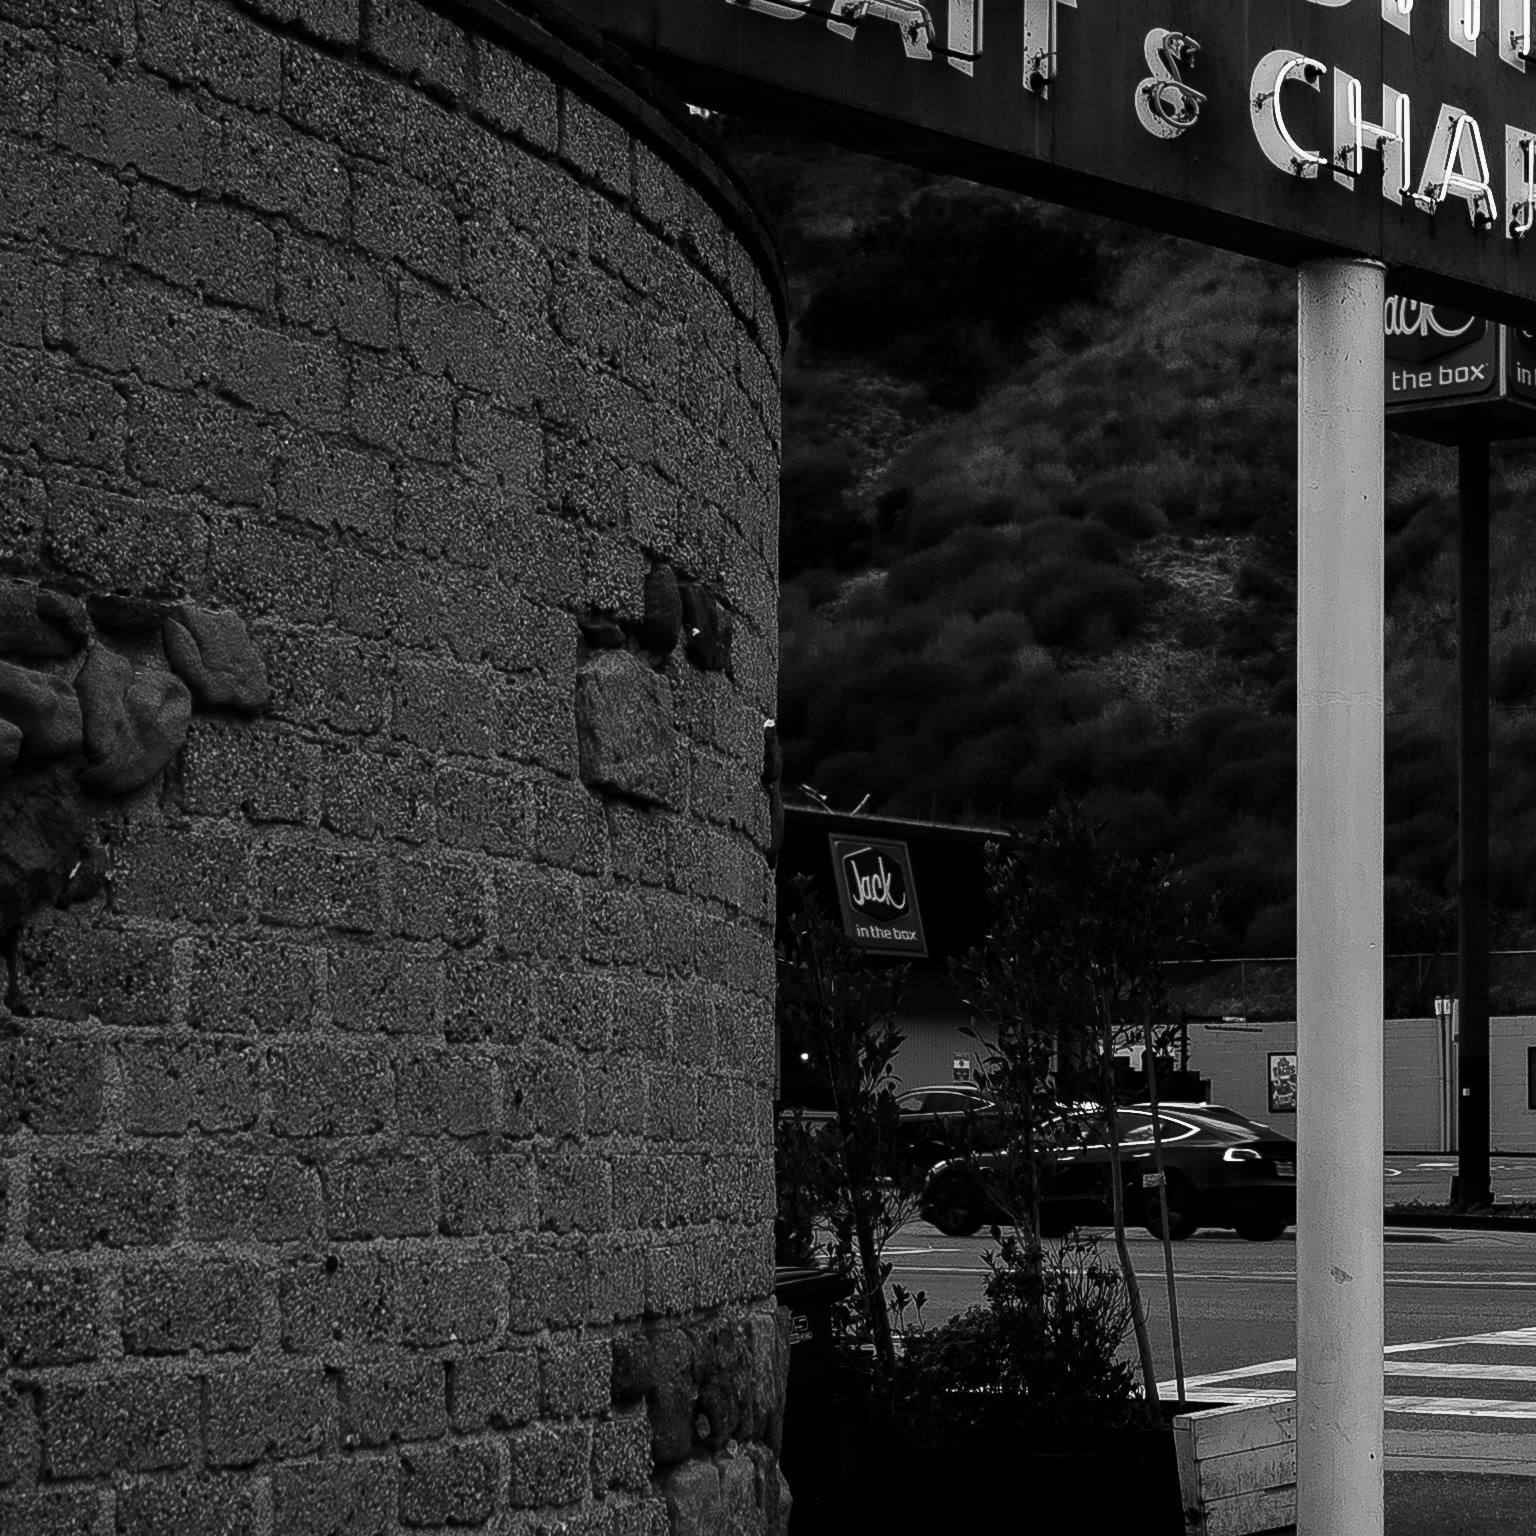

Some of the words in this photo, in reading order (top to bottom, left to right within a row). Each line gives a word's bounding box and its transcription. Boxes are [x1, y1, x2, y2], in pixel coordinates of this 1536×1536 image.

[1134, 27, 1207, 140] &
[1392, 370, 1432, 391] the
[1439, 363, 1485, 385] box
[1516, 361, 1531, 385] in
[850, 856, 906, 909] Jack
[855, 923, 870, 938] in
[870, 925, 892, 939] the
[894, 927, 917, 941] box
